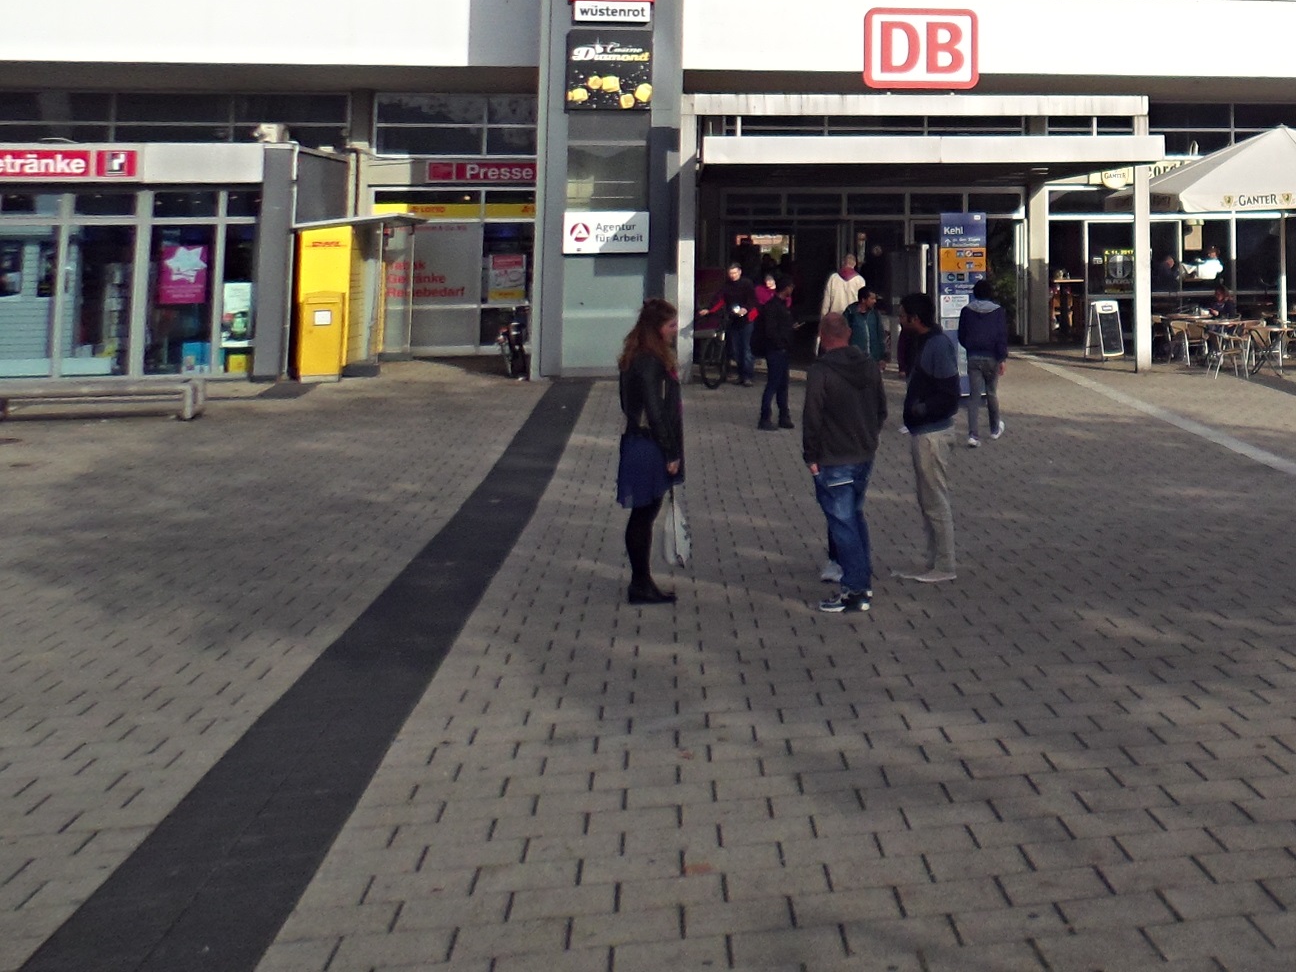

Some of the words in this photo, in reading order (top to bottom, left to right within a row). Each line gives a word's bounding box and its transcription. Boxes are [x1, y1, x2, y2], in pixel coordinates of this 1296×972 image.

[579, 3, 646, 18] wüstenrot
[880, 21, 965, 74] DB
[465, 164, 534, 179] Presse
[1238, 193, 1278, 207] GANTER
[595, 222, 637, 234] Agentur
[943, 226, 964, 235] Kehl
[595, 233, 609, 242] für
[612, 233, 643, 243] Arbeit
[387, 273, 446, 284] Getänke
[387, 287, 465, 298] Reiebedarf
